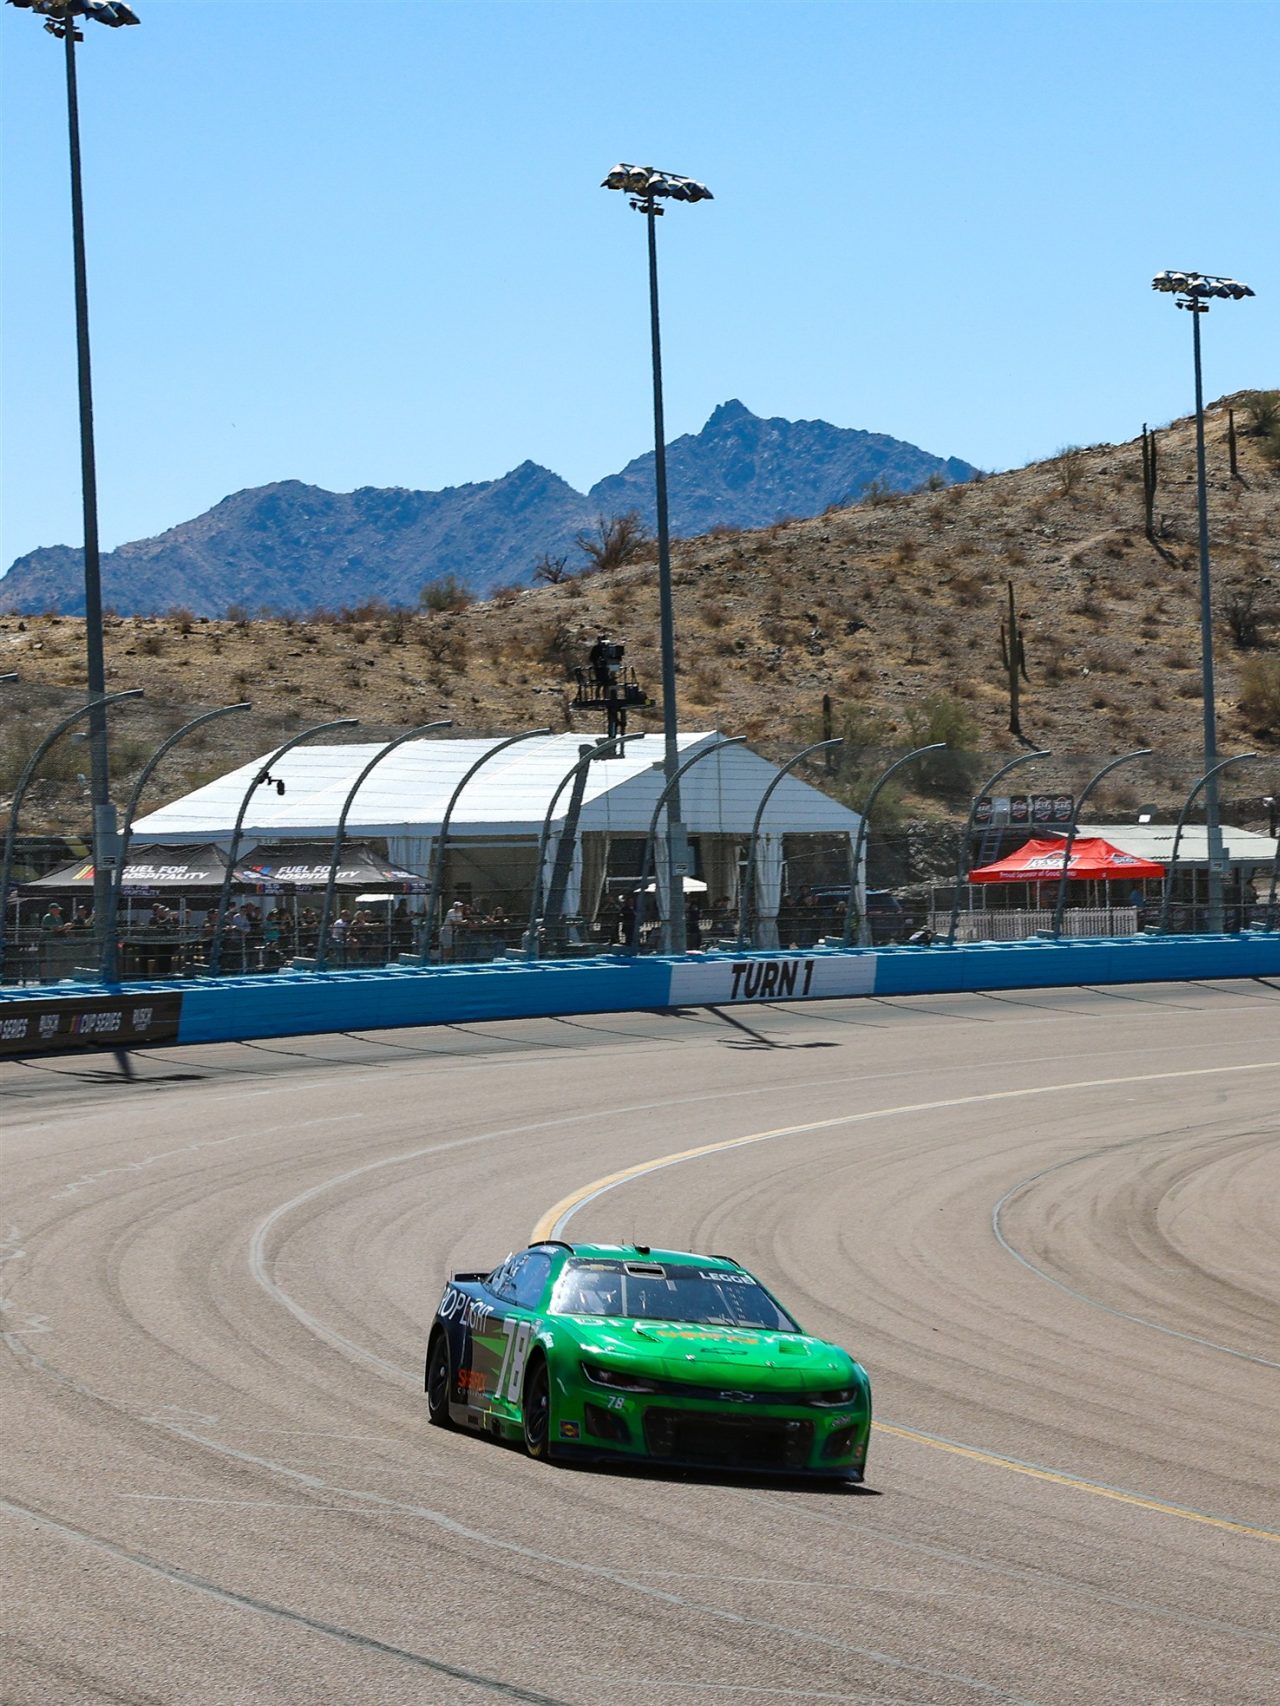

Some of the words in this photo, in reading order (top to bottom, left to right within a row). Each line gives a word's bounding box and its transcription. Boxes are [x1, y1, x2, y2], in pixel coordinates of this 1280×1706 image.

[122, 865, 156, 873] FUEL
[158, 865, 189, 874] FOR
[275, 871, 361, 880] HOSPITAITY
[277, 865, 310, 874] FUEL
[313, 865, 341, 874] FO
[730, 960, 798, 1000] TURN
[802, 959, 815, 996] 1
[95, 1011, 123, 1032] SERIES
[1, 1018, 29, 1040] SERIES
[698, 1271, 756, 1285] LEGGE
[494, 1316, 532, 1404] 78
[607, 1395, 625, 1409] 78
